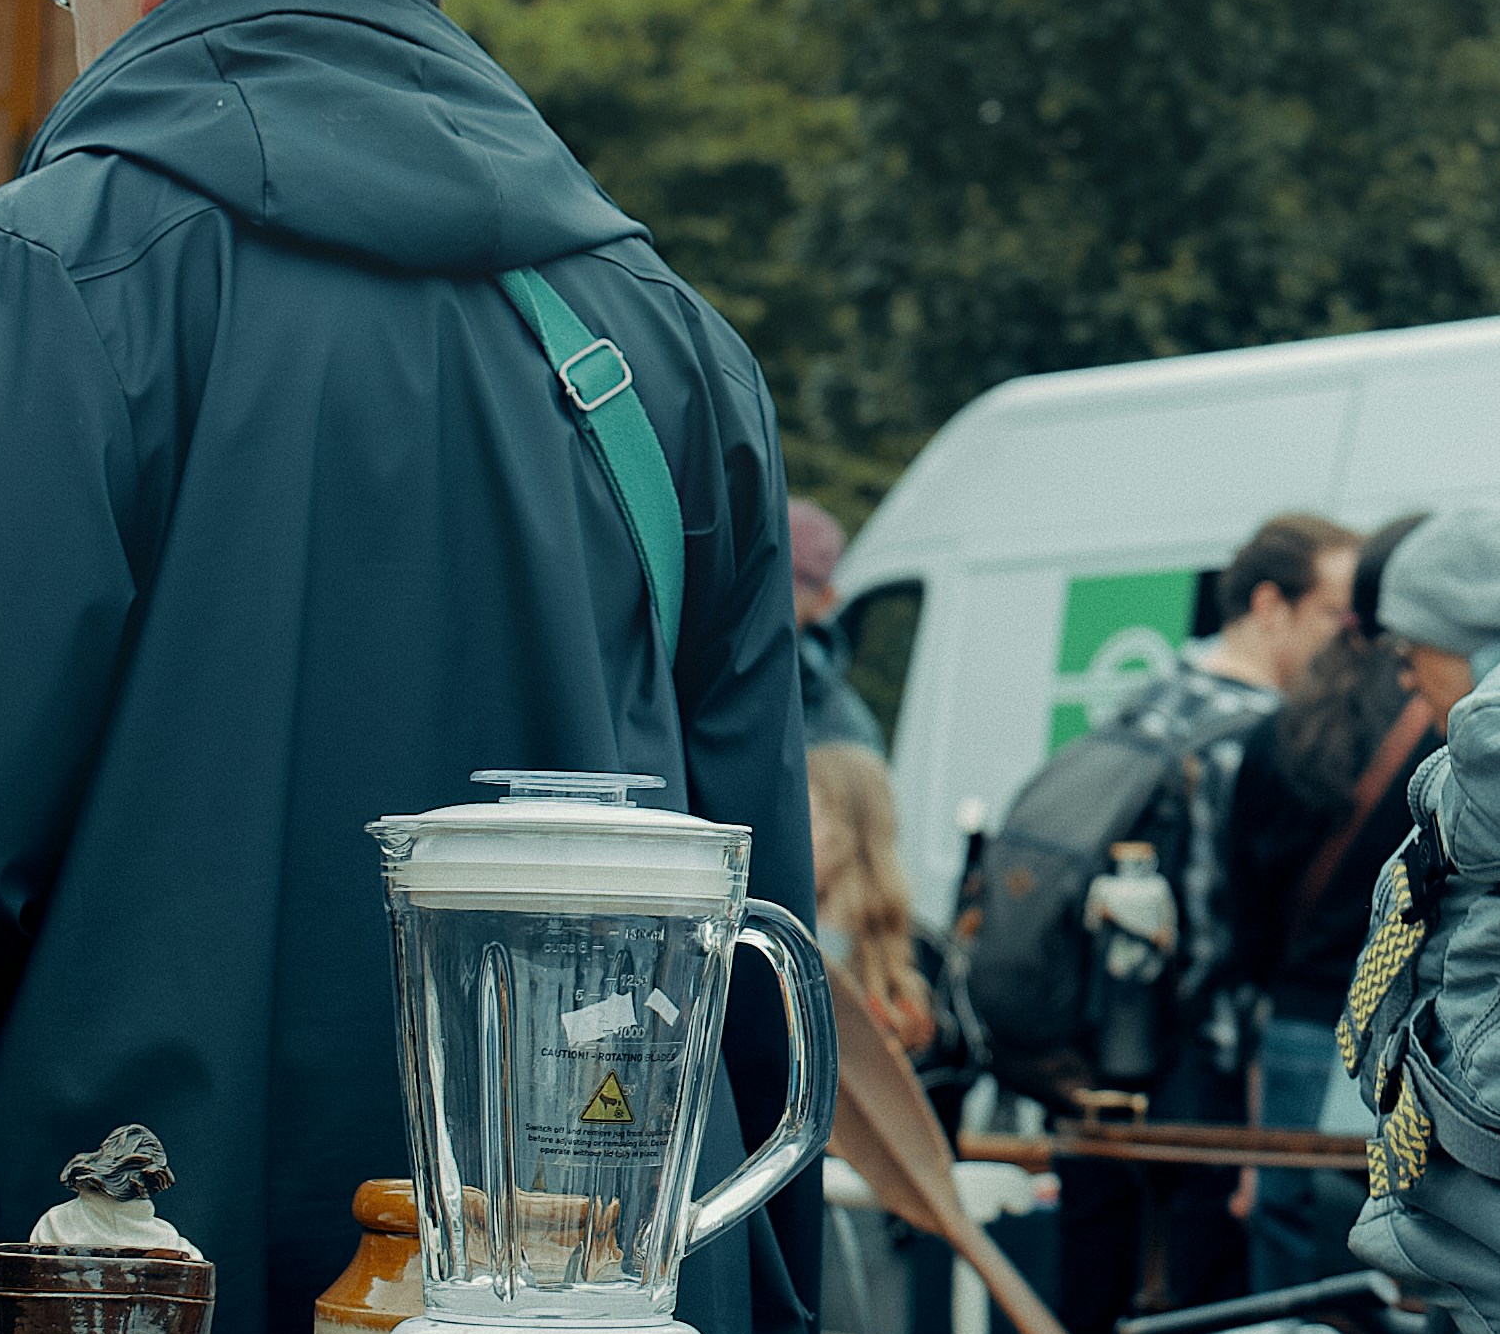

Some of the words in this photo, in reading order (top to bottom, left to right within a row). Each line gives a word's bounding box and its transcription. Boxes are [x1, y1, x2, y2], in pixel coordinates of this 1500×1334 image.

[617, 1026, 646, 1039] 1000
[541, 1047, 589, 1060] CAUTION!
[598, 1052, 642, 1062] ROTATING
